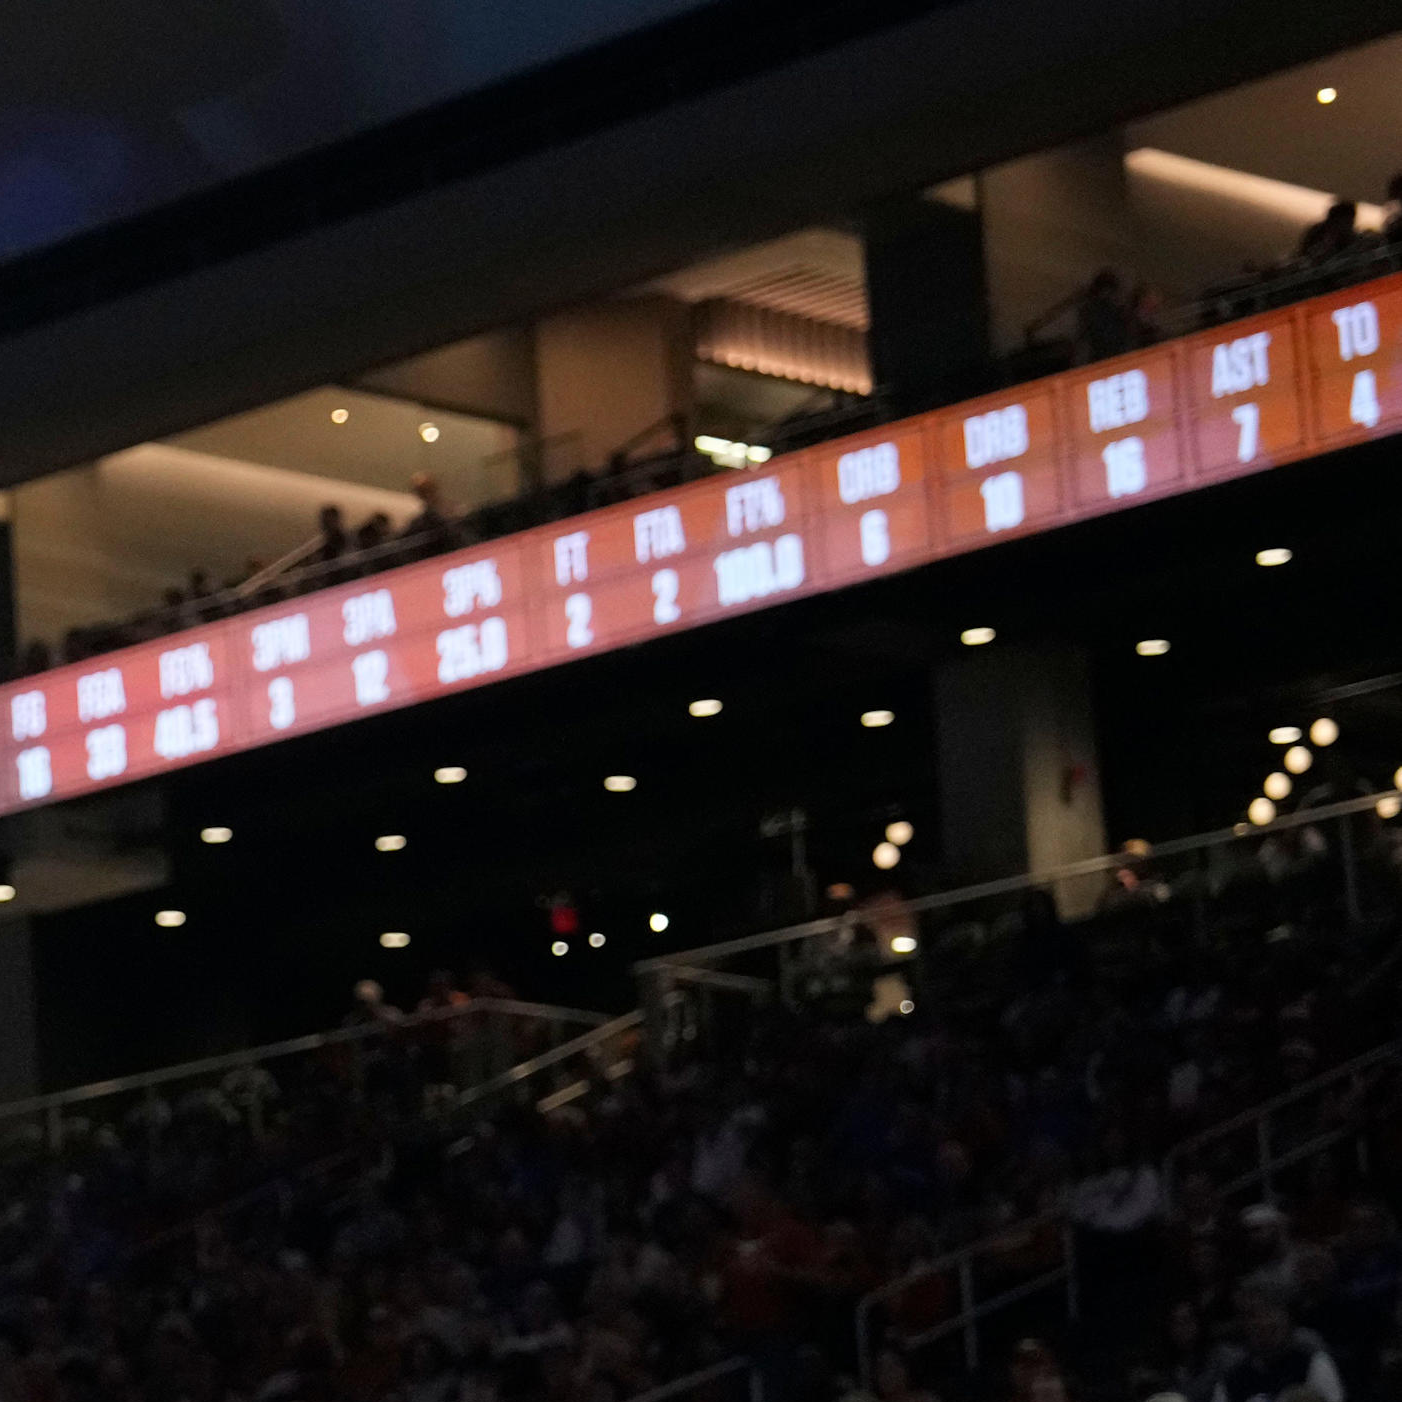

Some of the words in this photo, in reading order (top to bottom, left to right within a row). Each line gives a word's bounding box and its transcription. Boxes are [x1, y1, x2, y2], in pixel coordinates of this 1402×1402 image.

[1212, 332, 1270, 398] AST
[565, 592, 594, 649] 2
[651, 569, 682, 625] 2
